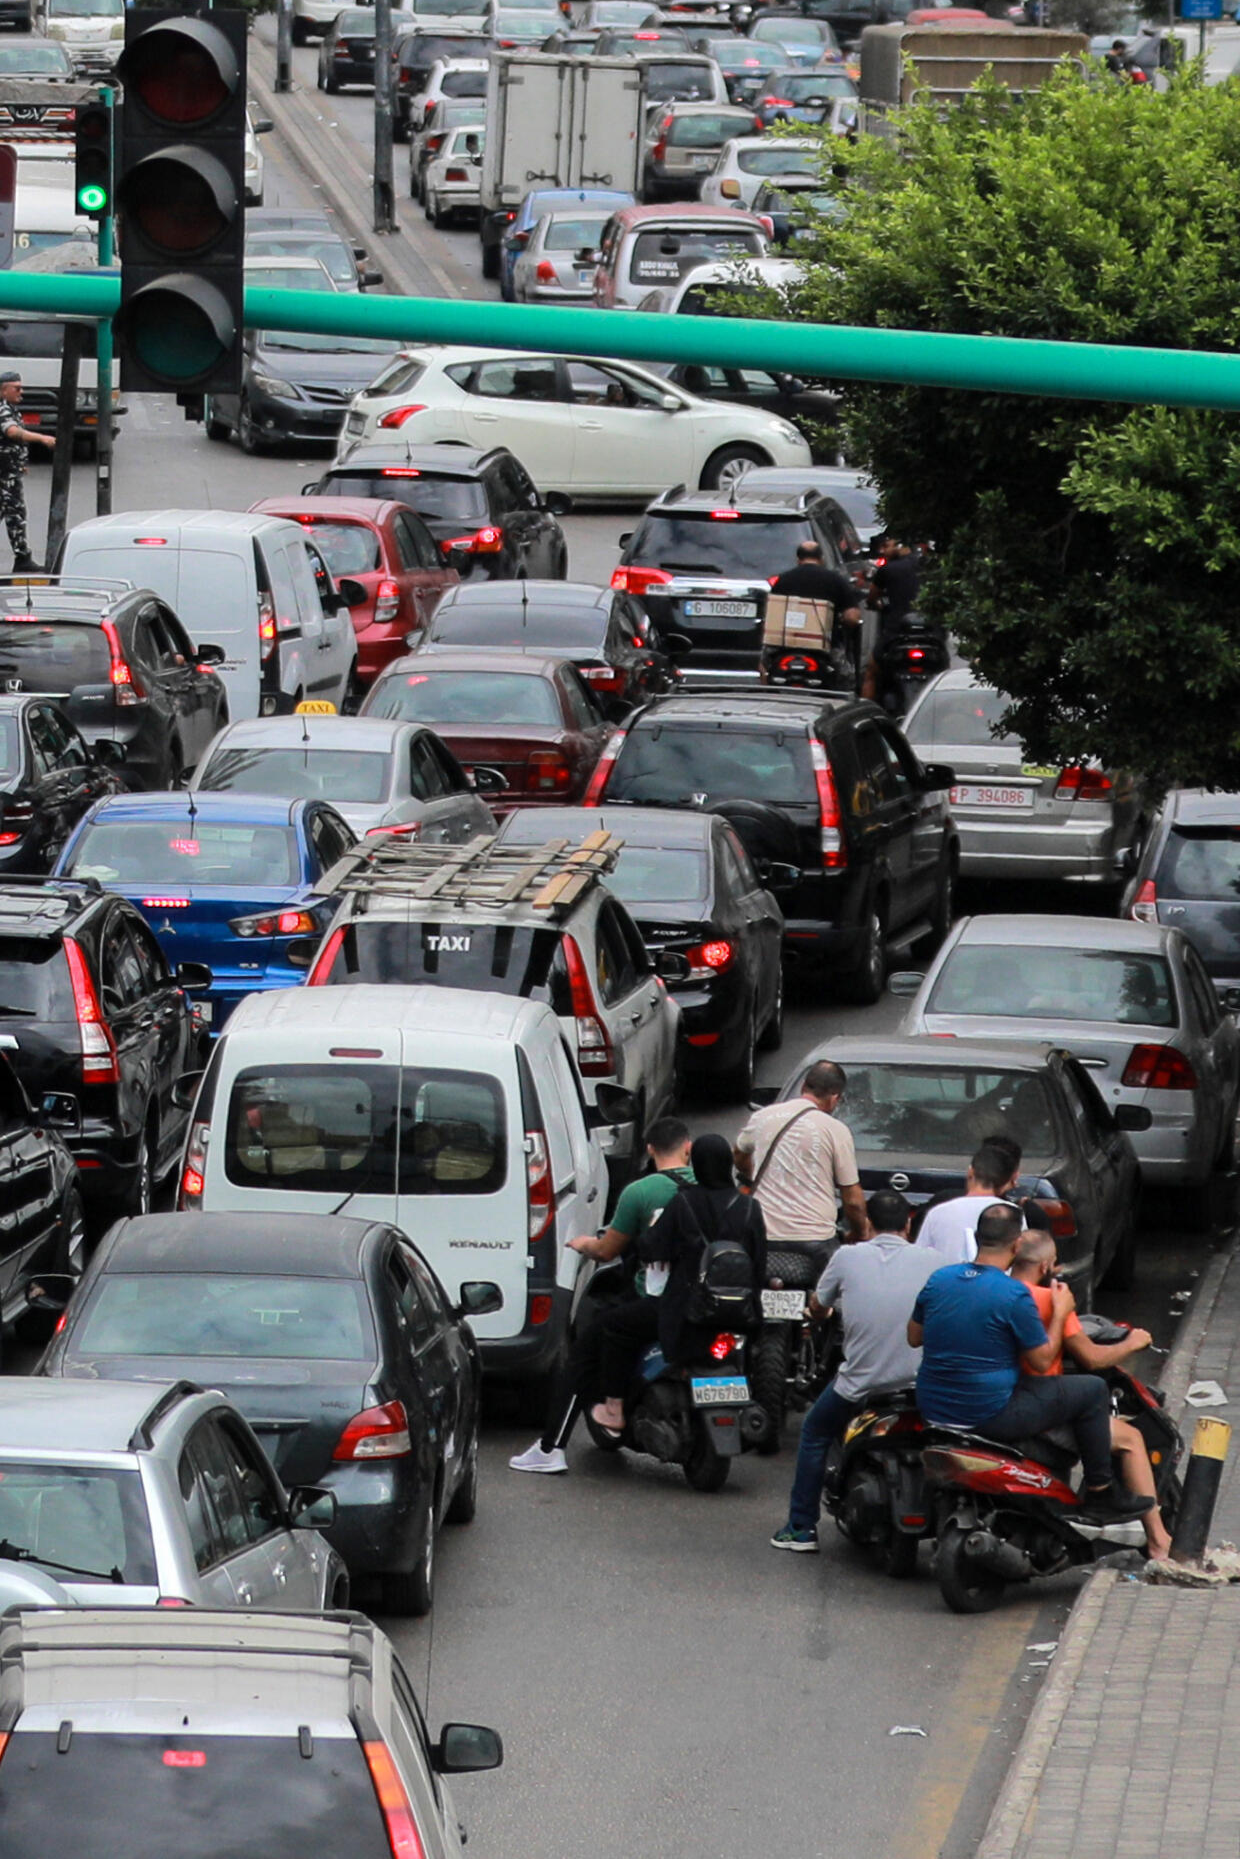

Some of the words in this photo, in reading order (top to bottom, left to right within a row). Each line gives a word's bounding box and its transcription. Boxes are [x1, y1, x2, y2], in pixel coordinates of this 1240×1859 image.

[302, 704, 330, 715] TAXI
[427, 936, 470, 951] TAXI
[449, 1241, 513, 1250] RENAULT
